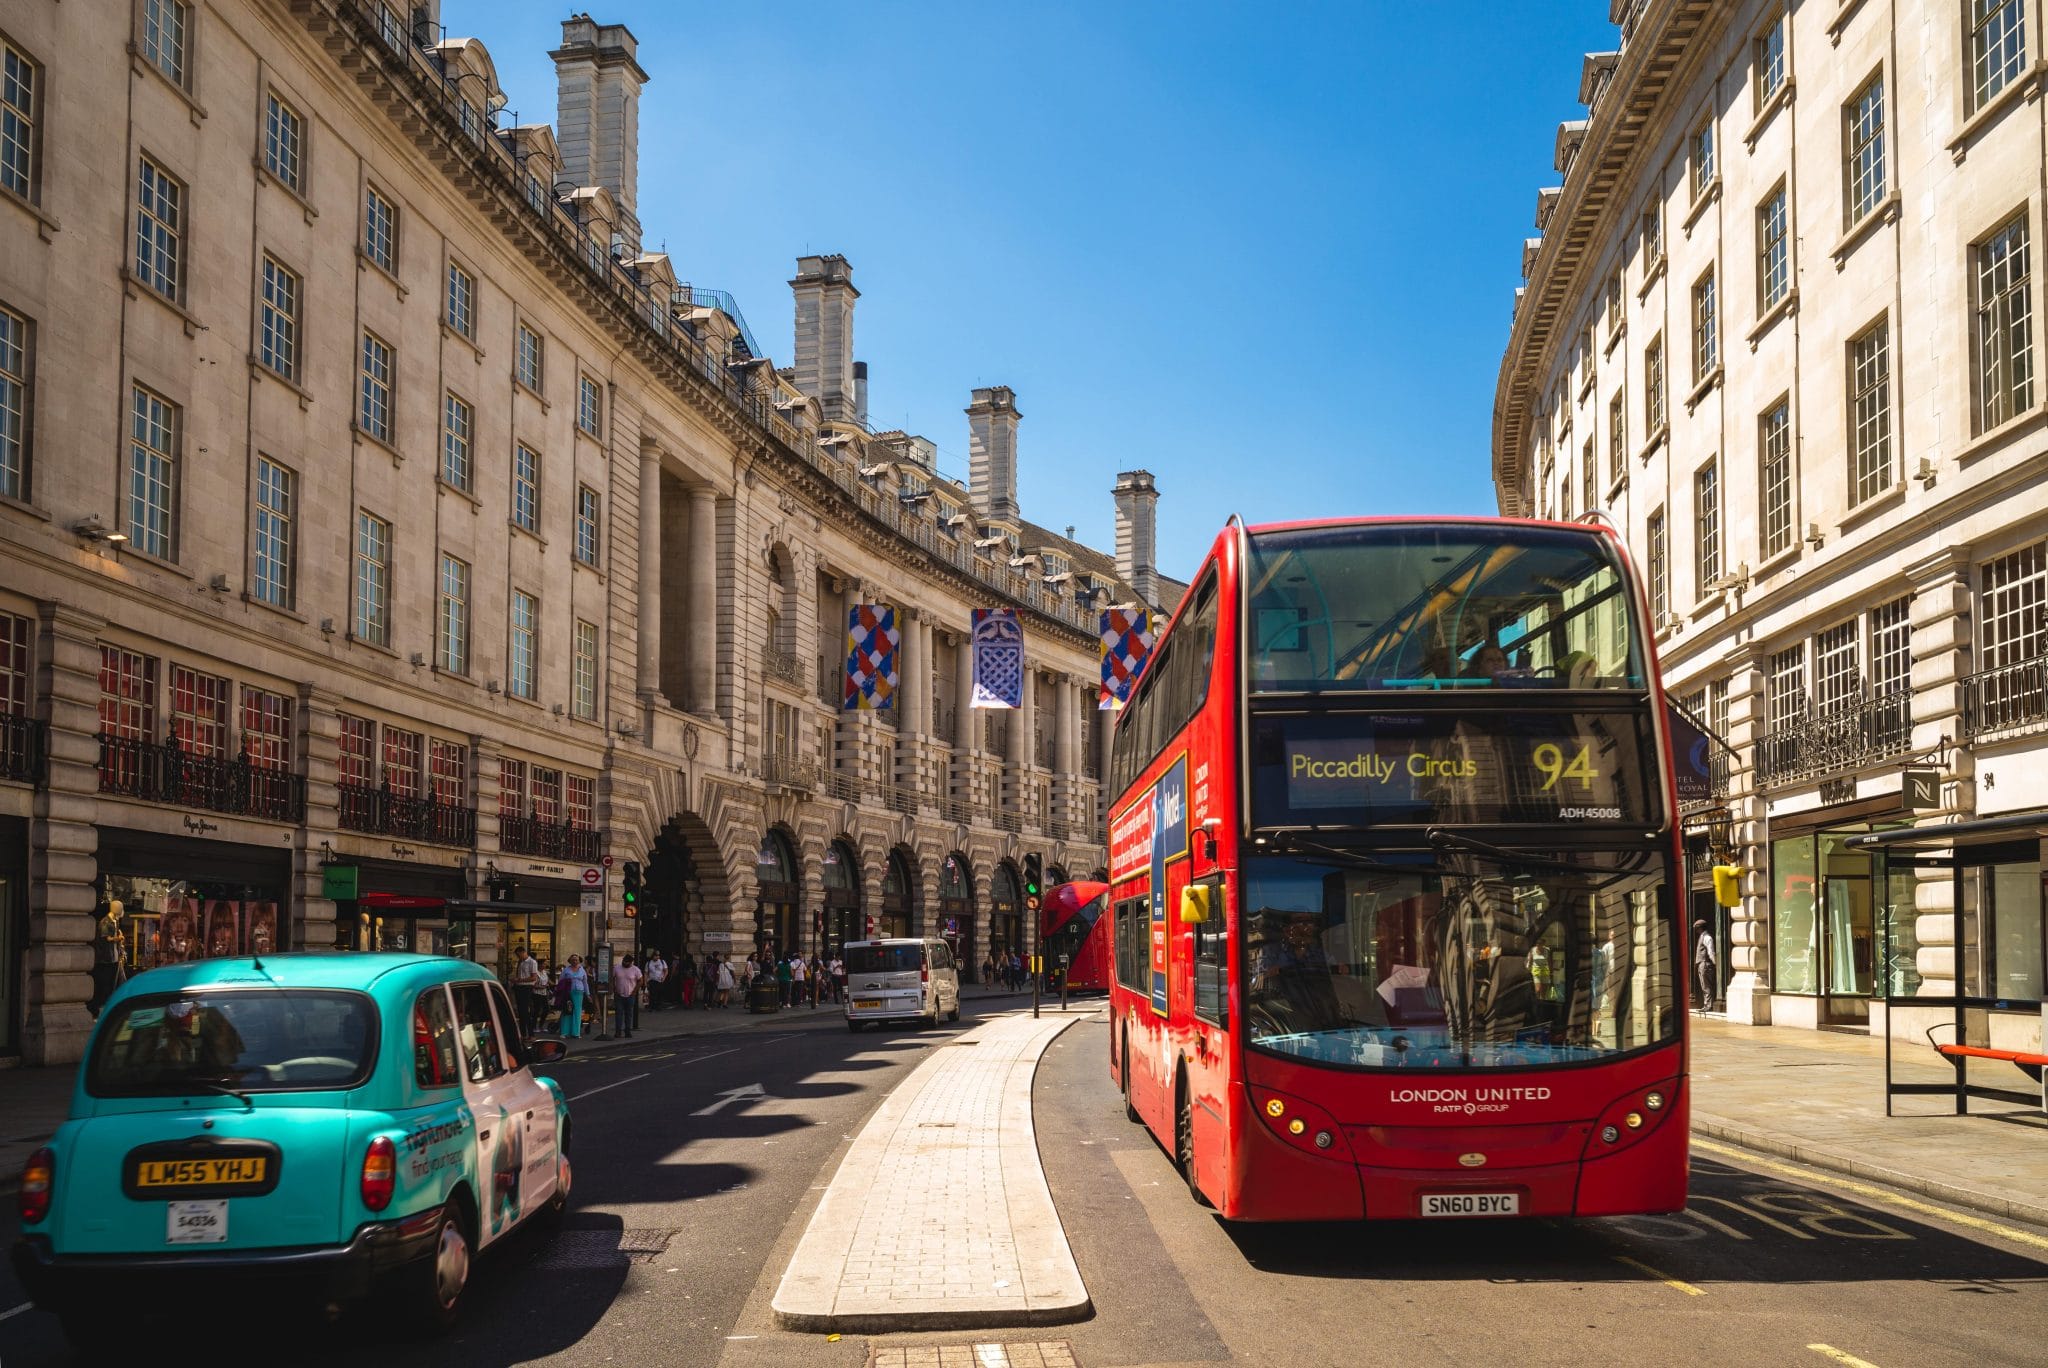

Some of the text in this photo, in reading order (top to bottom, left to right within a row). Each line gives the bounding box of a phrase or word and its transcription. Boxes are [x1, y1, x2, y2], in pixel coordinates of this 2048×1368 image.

[1291, 753, 1477, 784] Piccadilly Circus
[1533, 743, 1599, 791] 94
[1559, 808, 1621, 819] ADH45008
[283, 833, 291, 842] 59
[528, 864, 564, 874] JIMMY FAIRLY
[1070, 925, 1078, 933] 12
[1783, 910, 1793, 980] NEW
[1888, 904, 1900, 984] NEW
[1391, 1087, 1551, 1102] LONDON UNITED
[1434, 1104, 1509, 1113] RATP GROUP
[147, 1160, 258, 1184] LM55 YHJ
[1429, 1195, 1512, 1213] SN60 BYC
